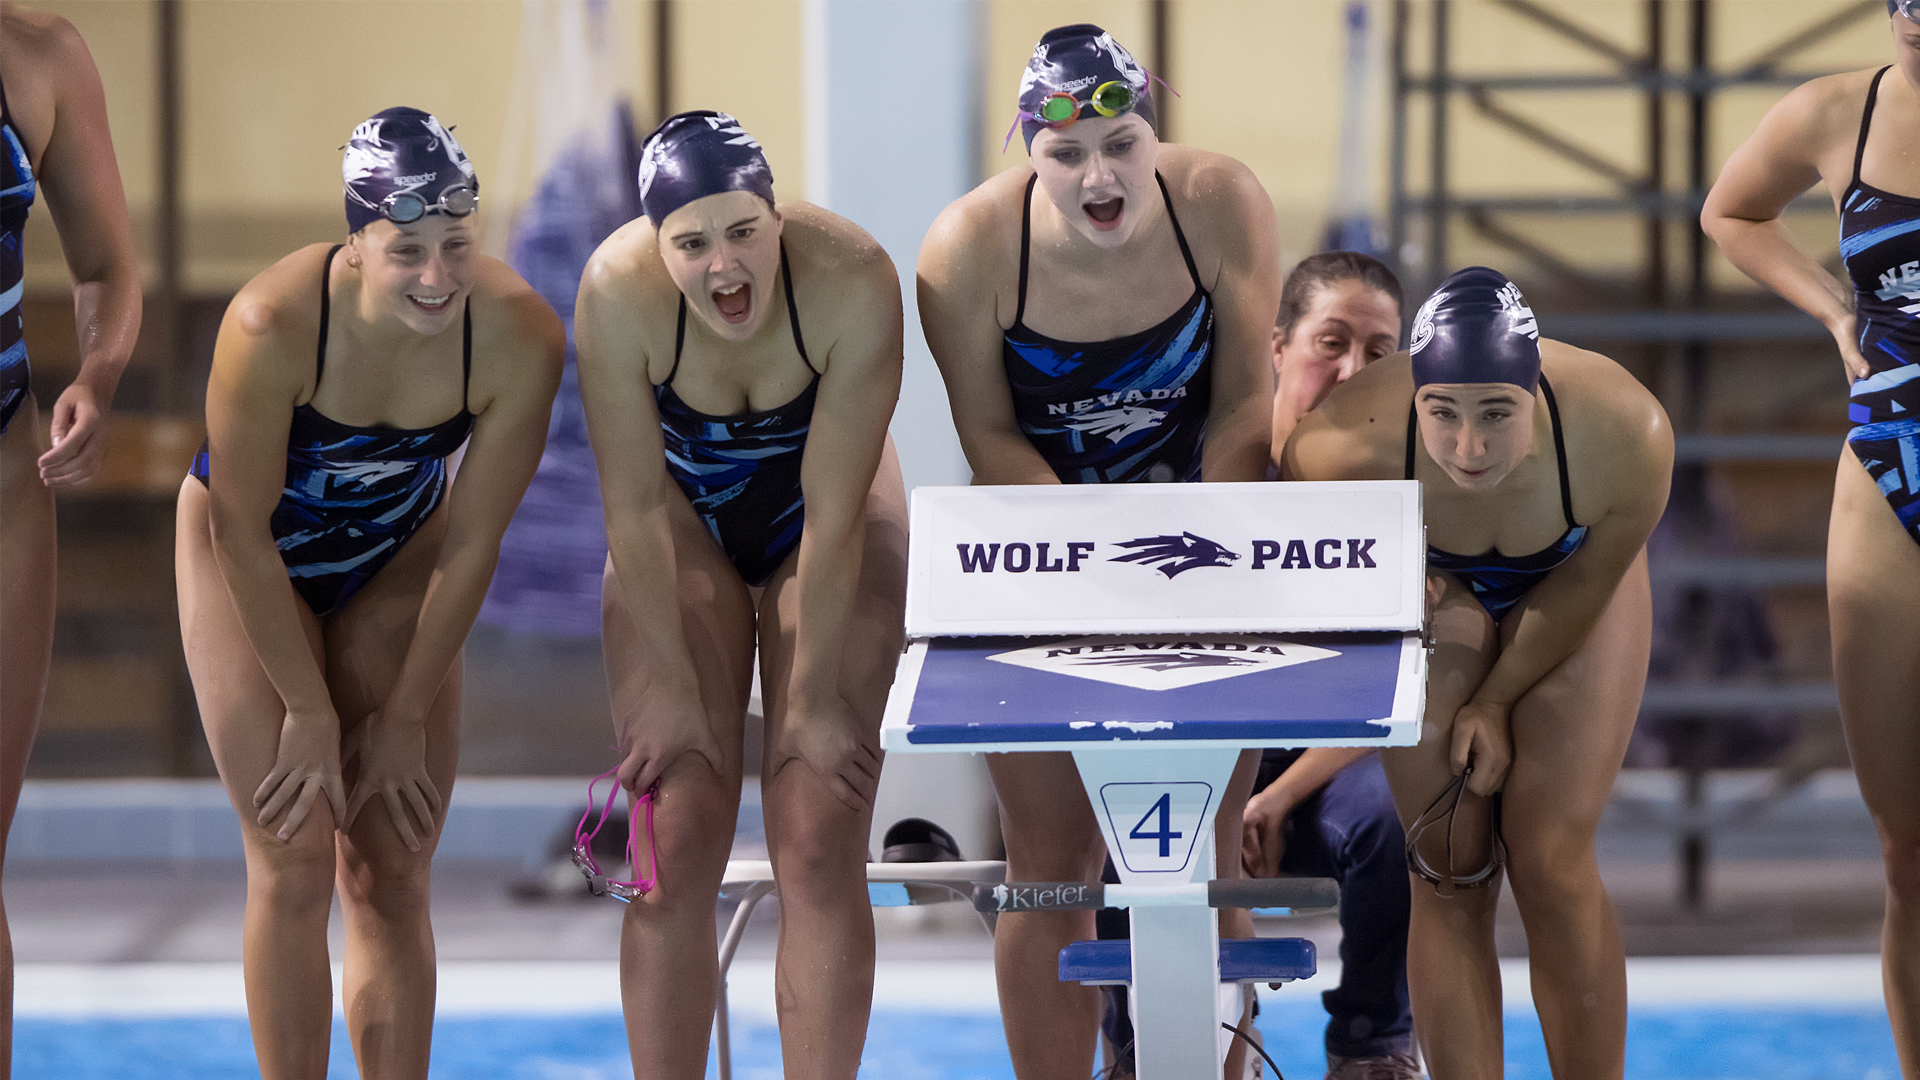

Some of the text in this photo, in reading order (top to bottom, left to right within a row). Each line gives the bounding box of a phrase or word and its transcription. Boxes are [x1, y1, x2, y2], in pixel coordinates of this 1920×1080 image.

[1055, 75, 1097, 92] speedo
[394, 172, 437, 187] speedo
[1047, 386, 1188, 415] NEVADA
[956, 538, 1377, 573] WOLF PACK
[1045, 642, 1286, 658] NEVADA
[1129, 793, 1182, 857] 4
[1012, 884, 1088, 908] Kiefer
